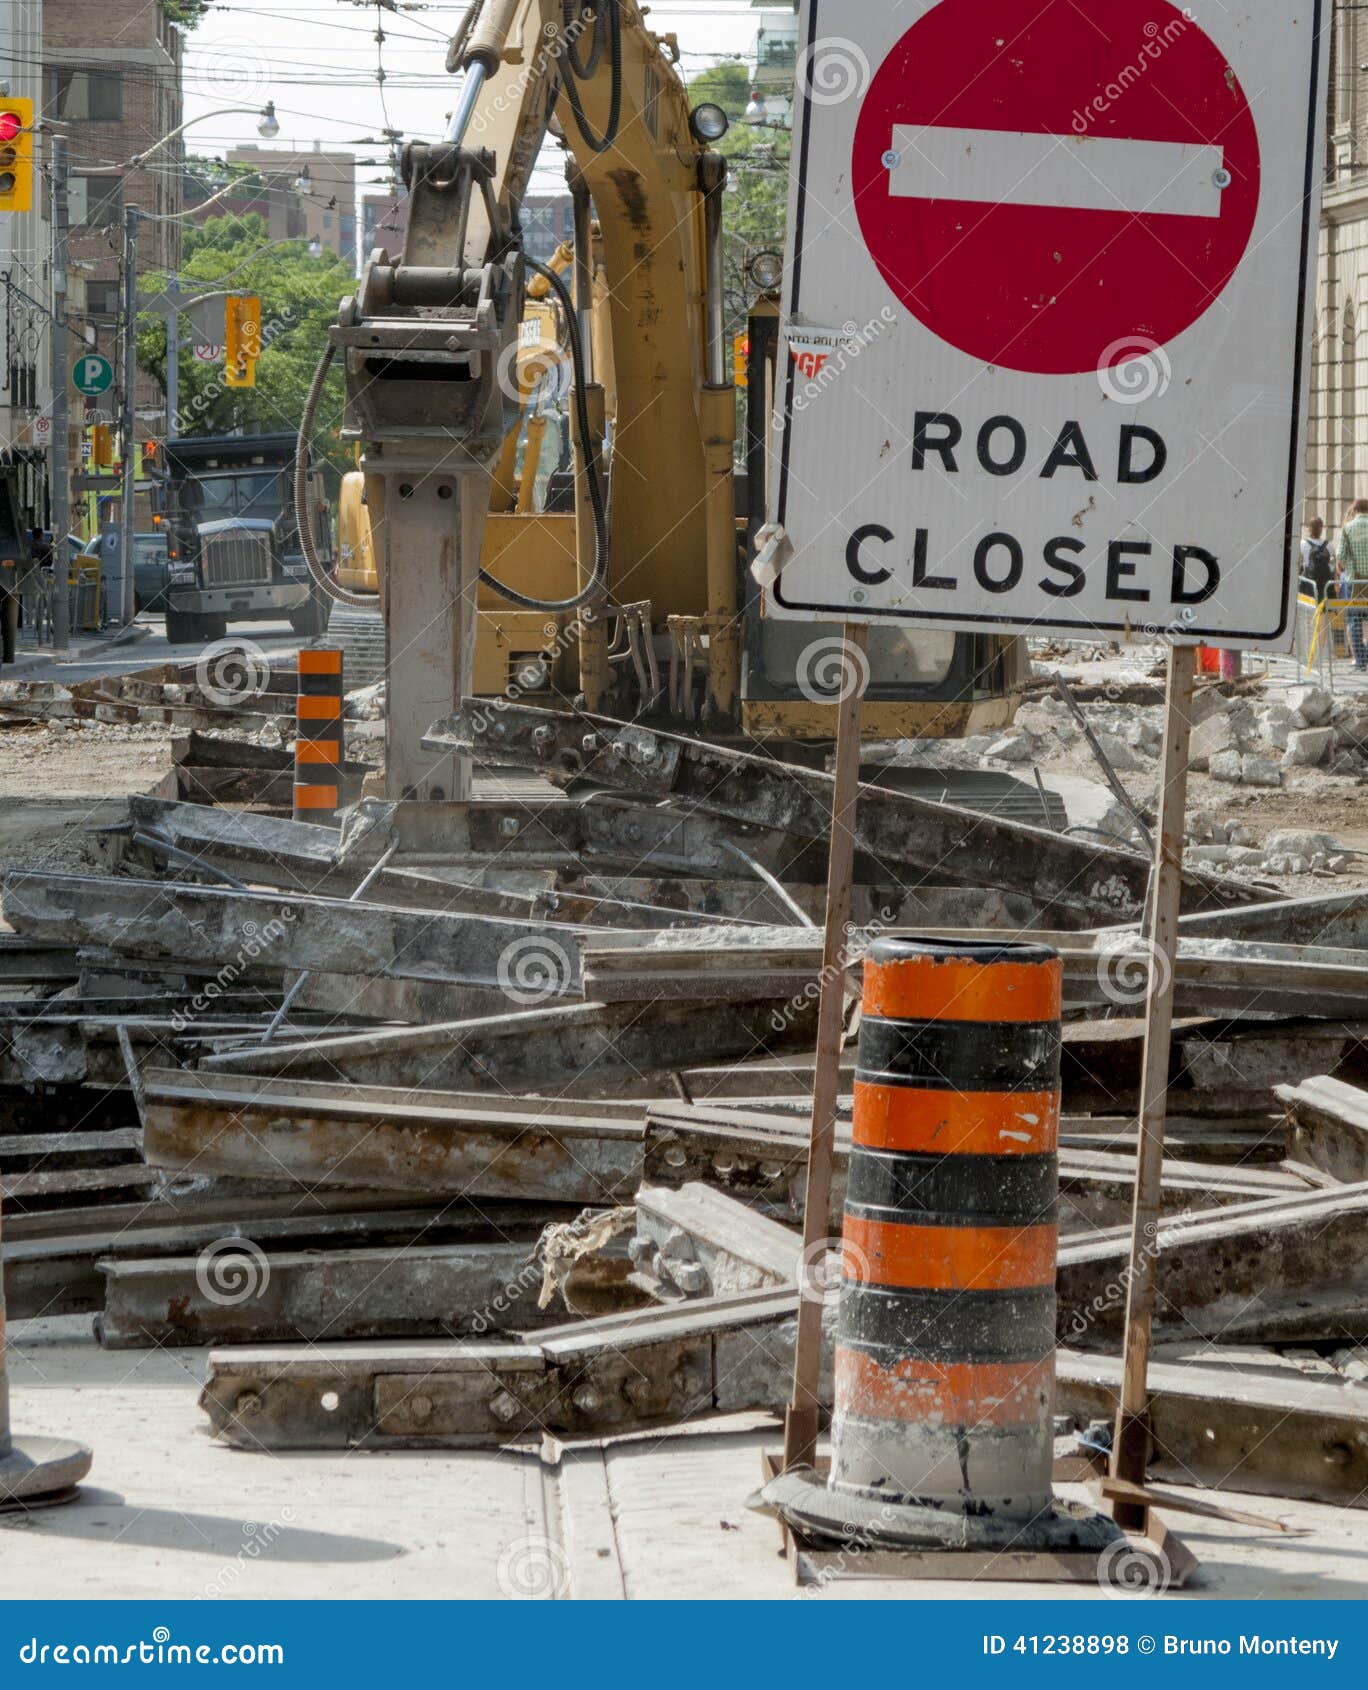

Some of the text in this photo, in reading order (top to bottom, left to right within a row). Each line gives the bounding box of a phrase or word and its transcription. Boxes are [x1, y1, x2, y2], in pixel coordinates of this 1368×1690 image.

[84, 359, 103, 386] P
[911, 411, 1168, 485] ROAD
[845, 523, 1222, 605] CLOSED
